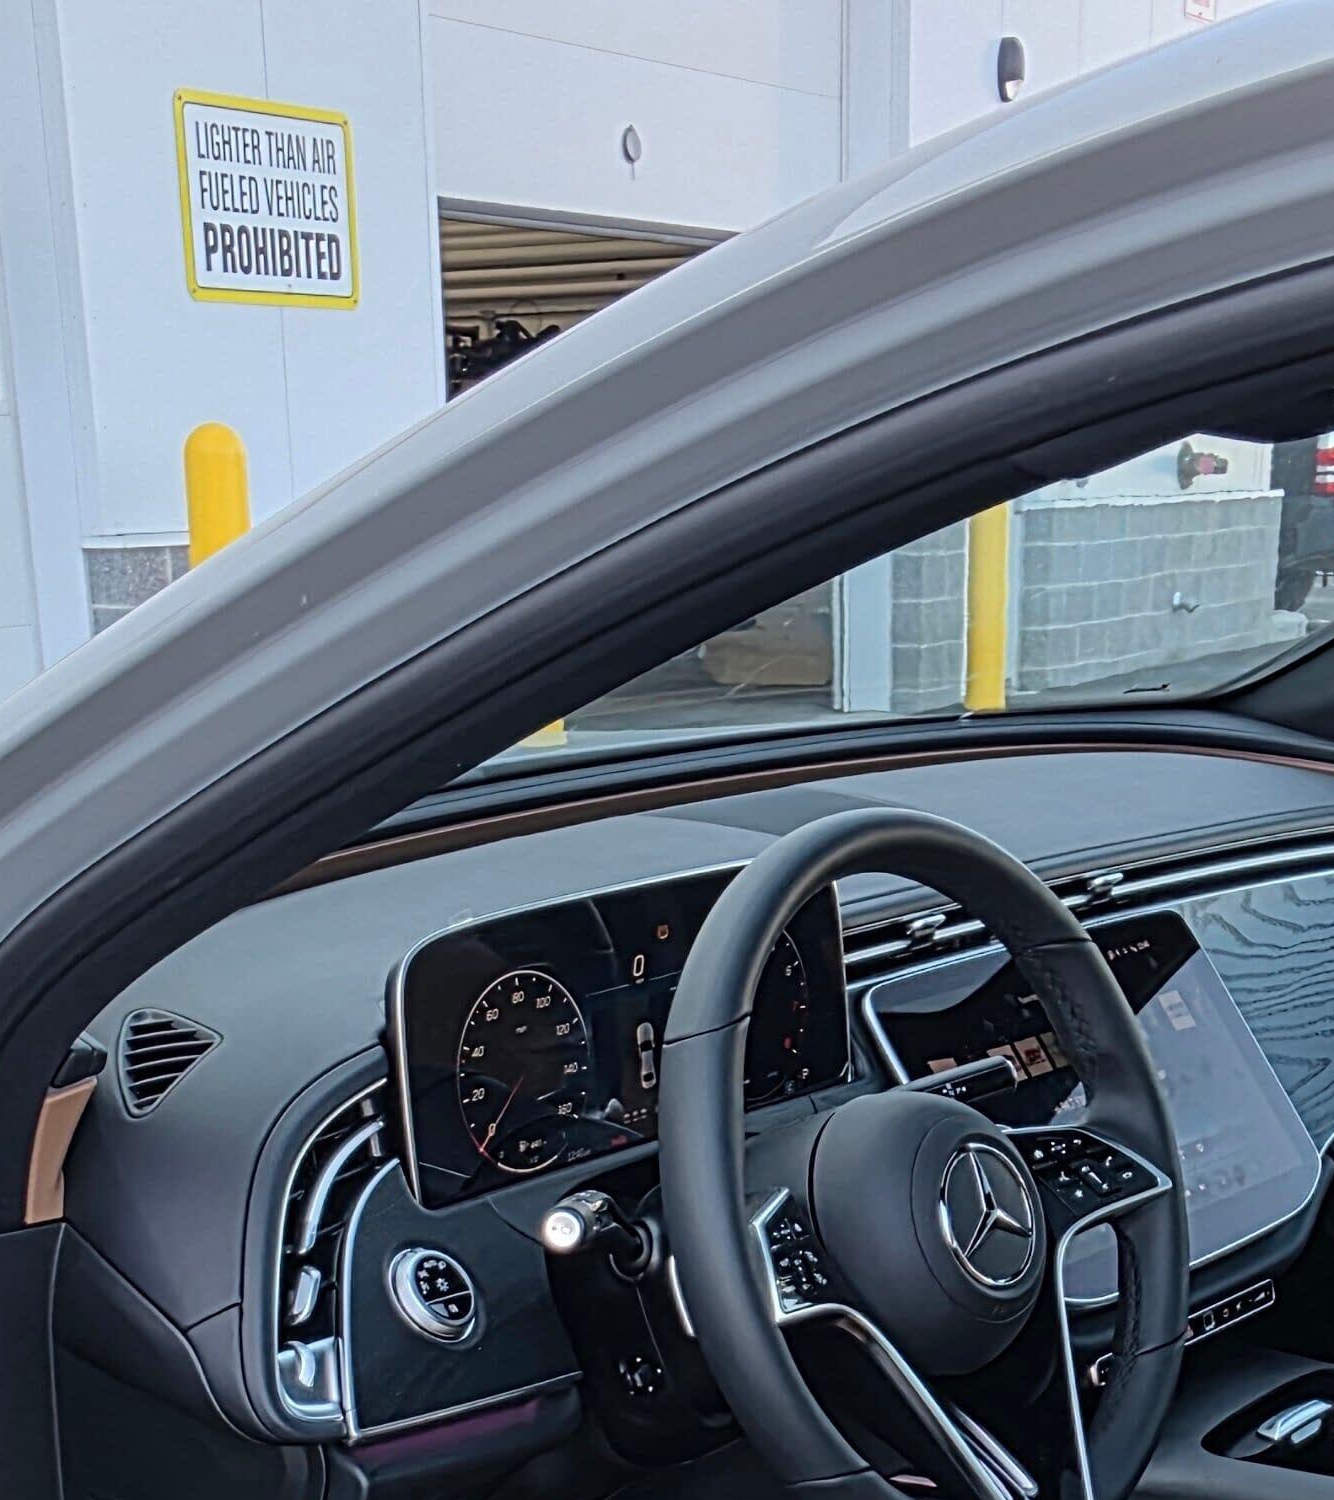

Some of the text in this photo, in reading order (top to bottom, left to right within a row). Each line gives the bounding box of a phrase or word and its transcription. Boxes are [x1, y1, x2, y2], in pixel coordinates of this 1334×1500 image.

[195, 121, 337, 175] LIGHTER THAN AIR
[199, 170, 339, 223] FUELED VEHICLES
[203, 222, 342, 281] PROHIBITED
[633, 954, 645, 976] 0
[536, 995, 551, 1008] 100
[486, 1008, 499, 1021] 60
[472, 1045, 485, 1057] 40
[472, 1088, 485, 1101] 20
